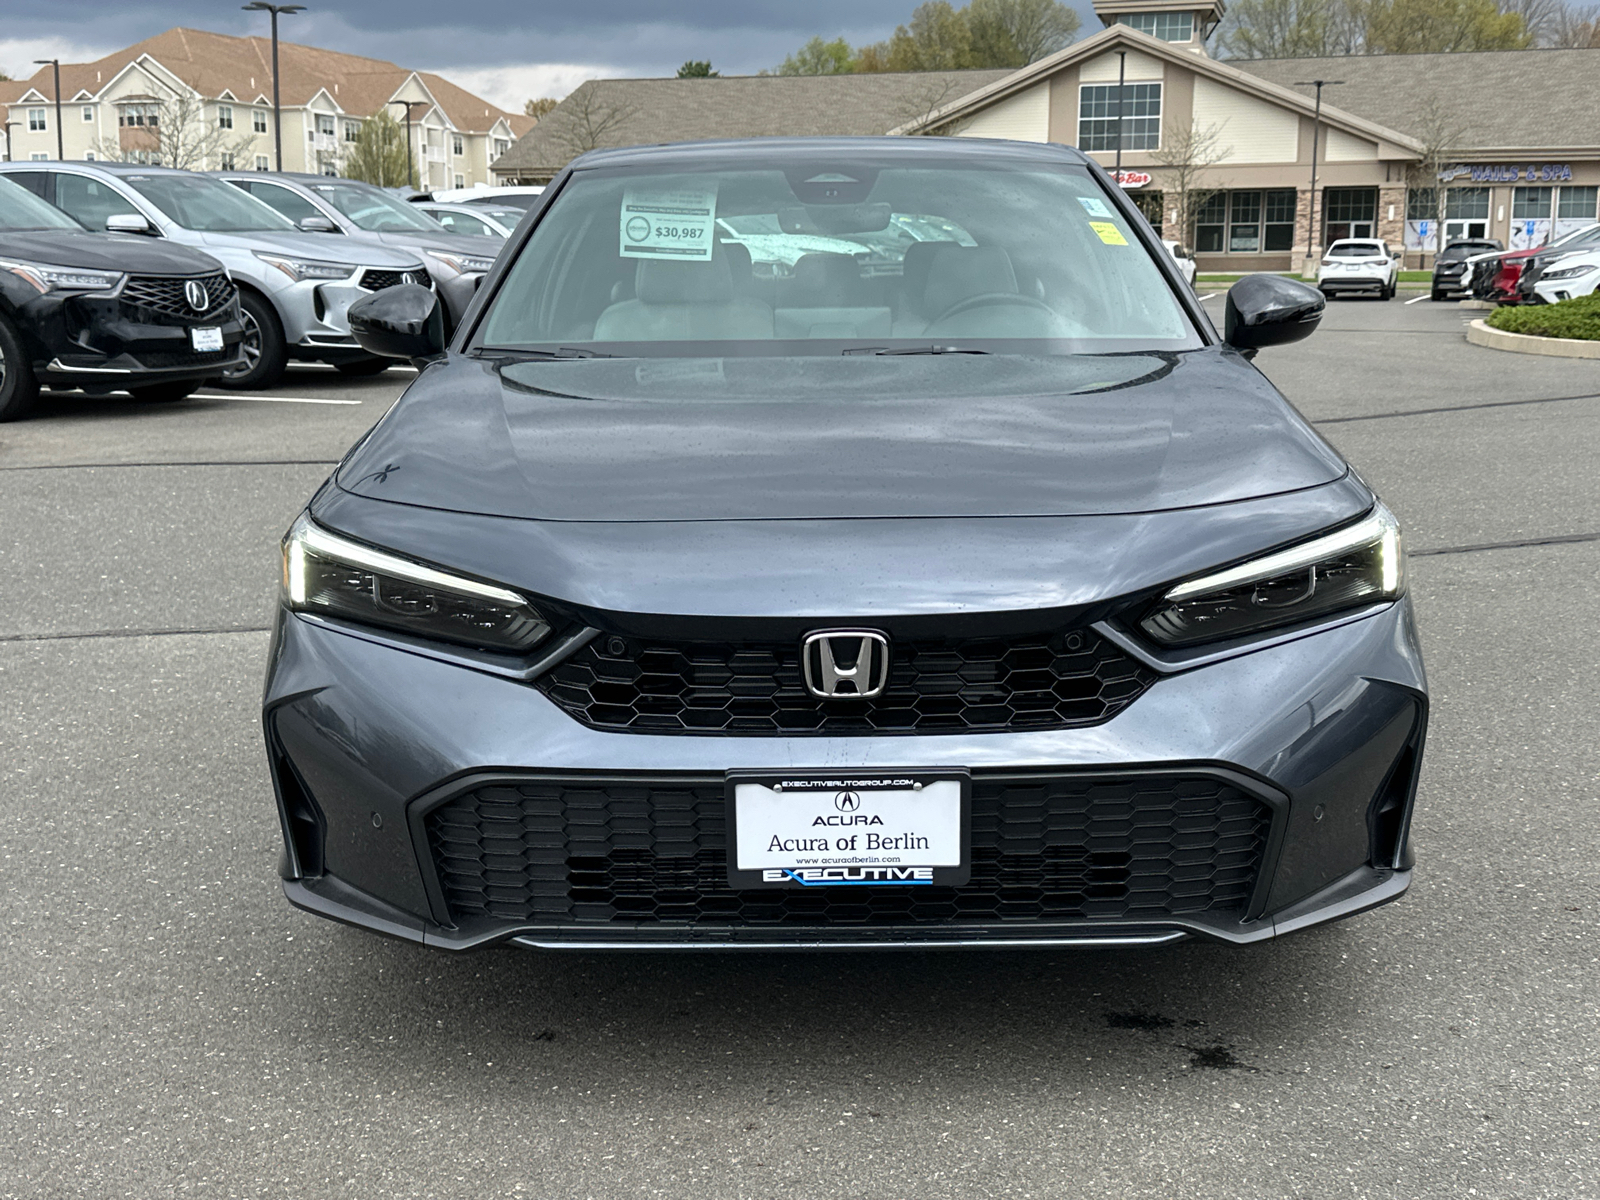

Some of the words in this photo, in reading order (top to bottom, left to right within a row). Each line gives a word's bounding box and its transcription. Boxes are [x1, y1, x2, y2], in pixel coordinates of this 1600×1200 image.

[1125, 172, 1149, 185] Bar
[1471, 165, 1519, 182] NAILS
[1525, 164, 1538, 182] &
[1541, 164, 1573, 181] SPA
[655, 226, 704, 240] $30,987
[812, 815, 884, 827] ACURA
[767, 834, 830, 852] Acura
[836, 834, 858, 851] of
[866, 832, 930, 850] Berlin
[796, 856, 901, 864] www.acuraofberlin.com
[762, 867, 934, 884] EXECUTIVE
